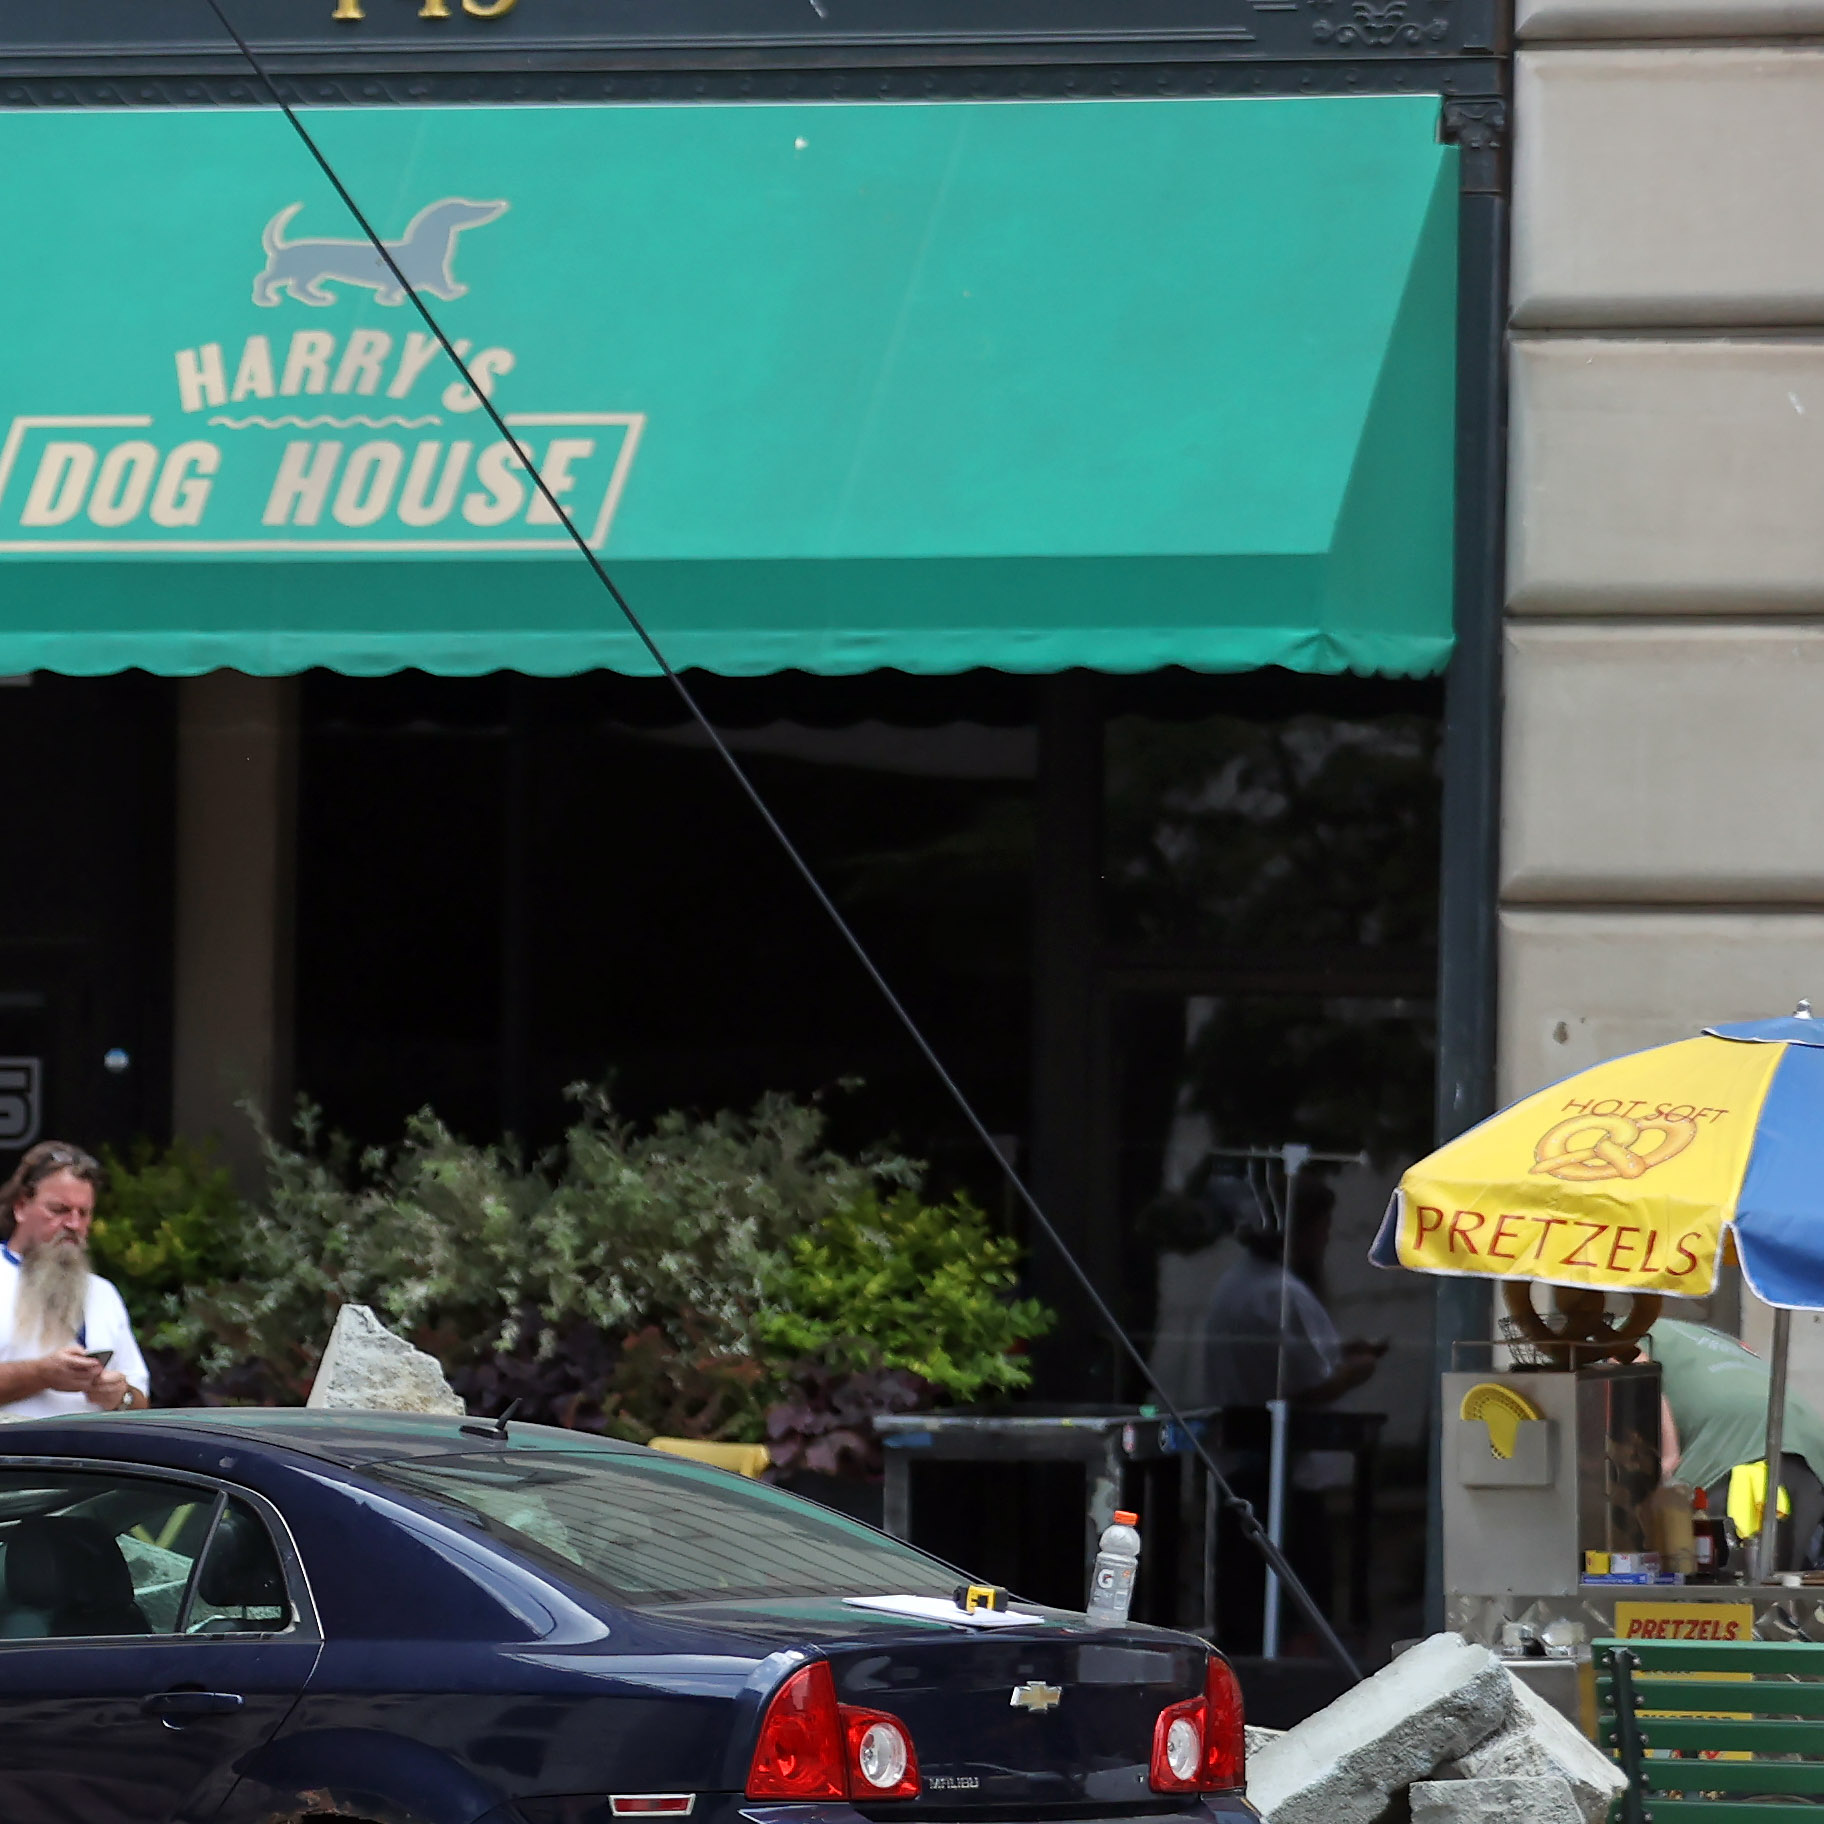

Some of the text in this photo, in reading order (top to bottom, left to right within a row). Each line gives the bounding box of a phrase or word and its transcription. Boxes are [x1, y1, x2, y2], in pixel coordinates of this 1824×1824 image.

[174, 329, 516, 413] HARRY'S
[19, 438, 595, 527] DOG HOUSE
[1560, 1098, 1731, 1125] HOT SOFT
[1413, 1205, 1704, 1277] PRETZELS
[1098, 1568, 1115, 1589] G
[1626, 1618, 1740, 1642] PRETZELS
[929, 1776, 980, 1790] MALIBU
